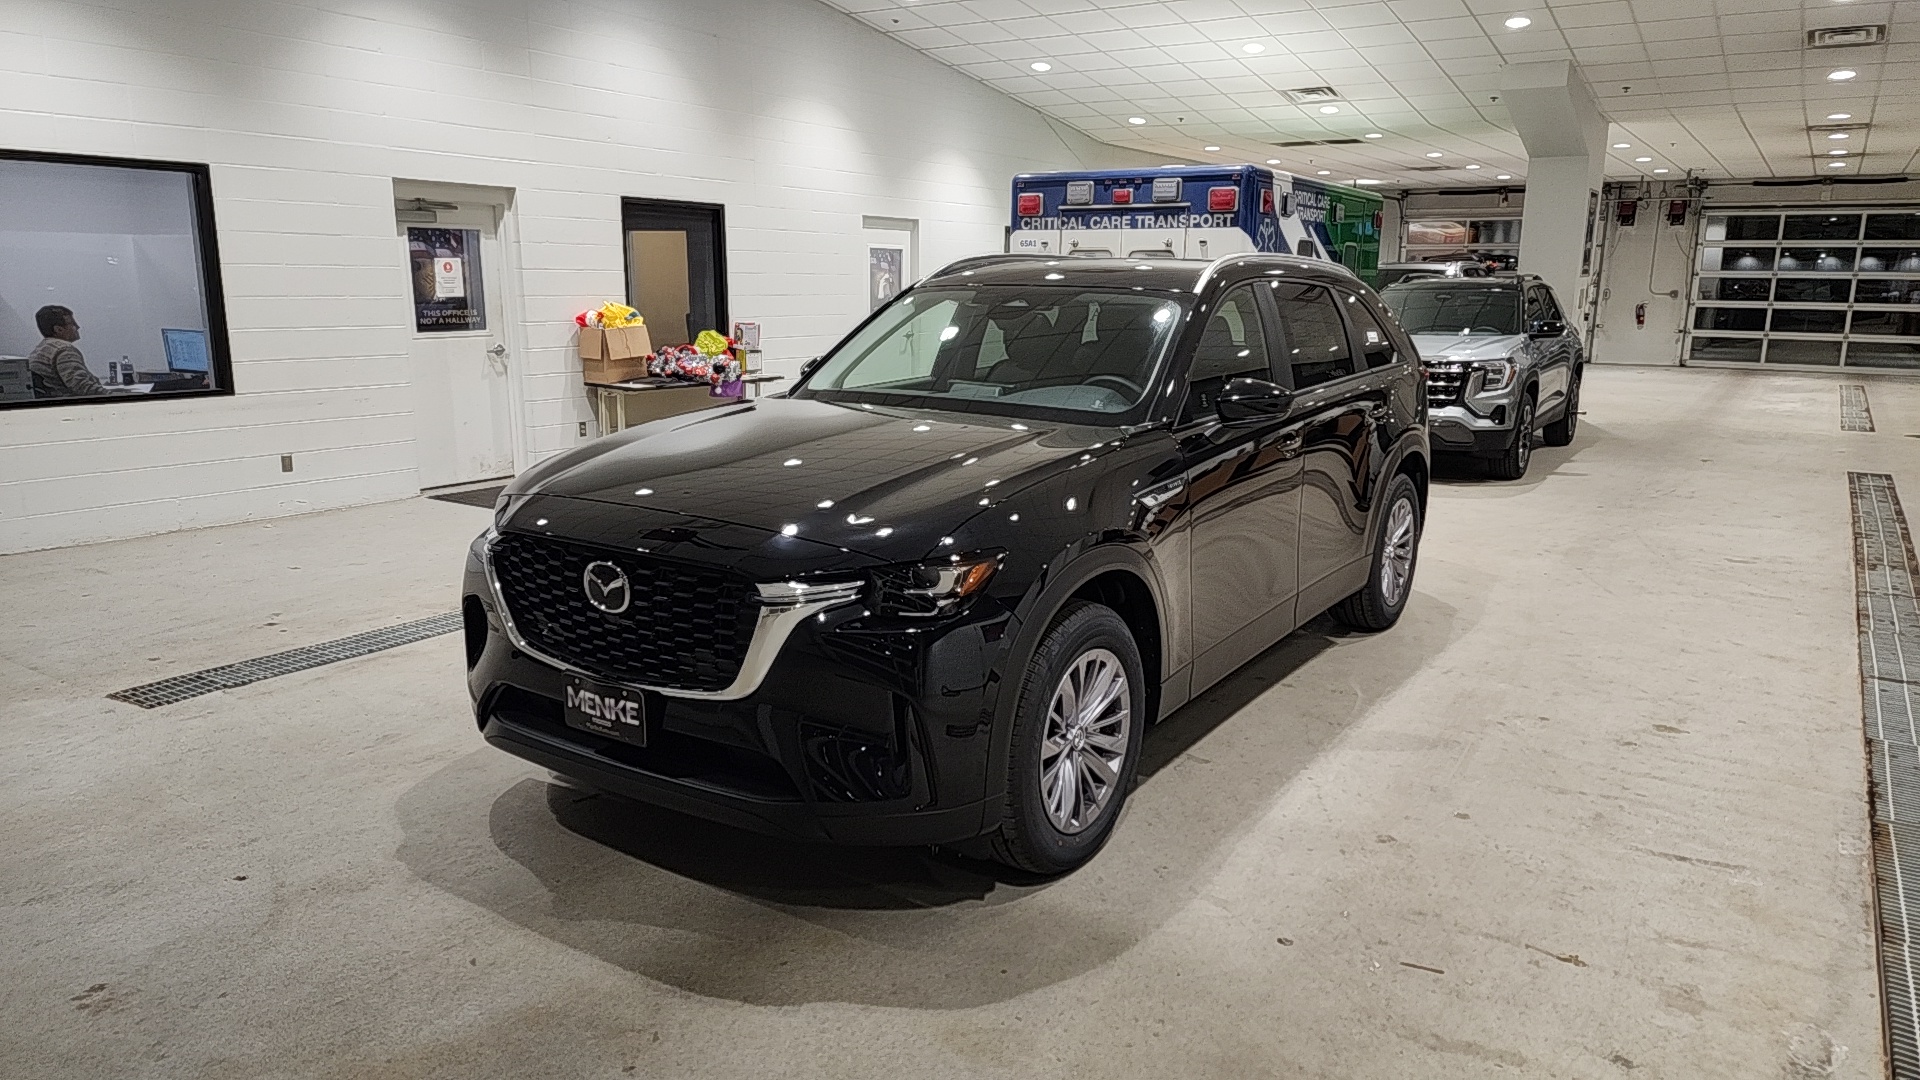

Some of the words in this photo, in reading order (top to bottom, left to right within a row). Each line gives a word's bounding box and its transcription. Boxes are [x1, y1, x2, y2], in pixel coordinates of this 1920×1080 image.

[1294, 190, 1317, 207] CRITICAL
[1318, 195, 1331, 209] CARE
[1020, 216, 1086, 230] CRITICAL
[1089, 215, 1131, 229] CARE
[1135, 213, 1234, 228] TRANSPORT
[1296, 206, 1327, 222] TRANSPORT
[1019, 239, 1037, 247] 65A1
[470, 308, 478, 316] IS
[438, 317, 444, 325] A
[445, 316, 481, 324] HALLWAY
[567, 686, 640, 725] MENKE
